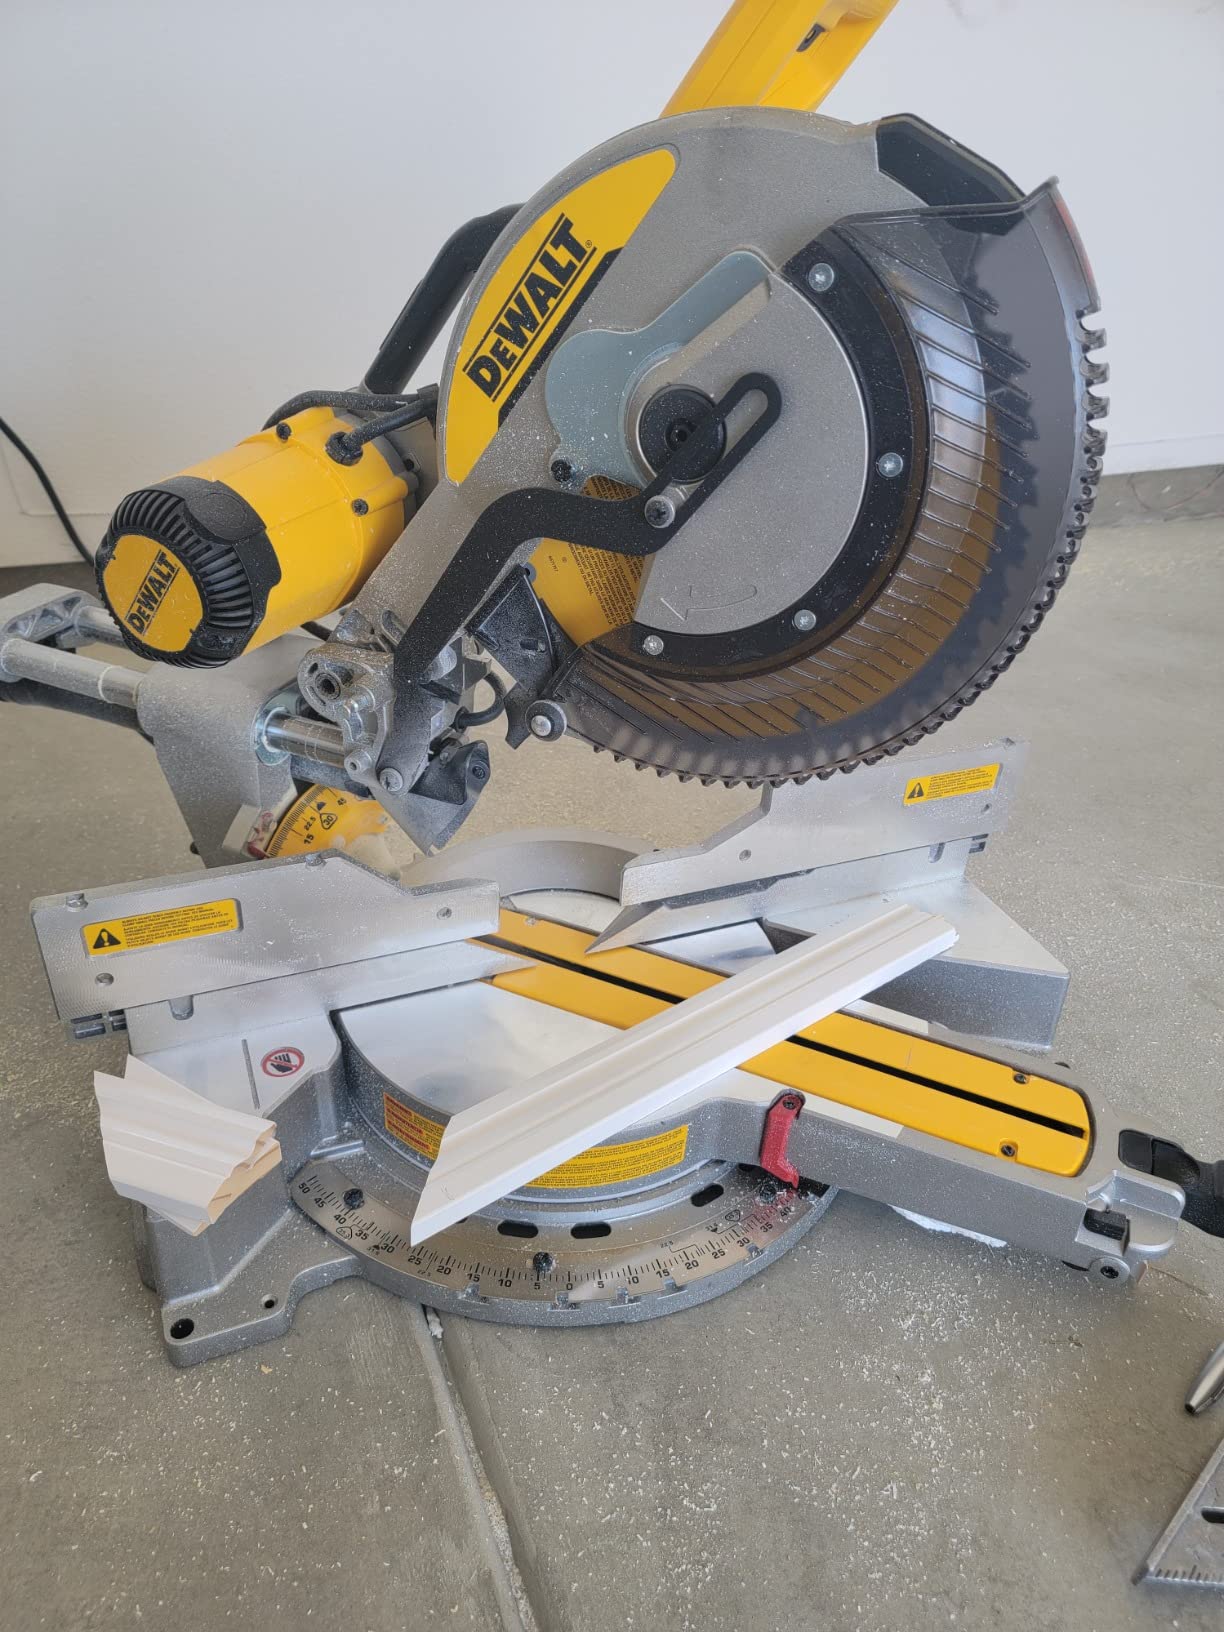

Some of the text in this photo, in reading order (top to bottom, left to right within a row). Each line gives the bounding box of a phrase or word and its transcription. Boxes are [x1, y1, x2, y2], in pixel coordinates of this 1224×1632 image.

[466, 216, 588, 398] DEWALT
[303, 833, 315, 845] 15
[322, 815, 333, 826] 30
[298, 1182, 311, 1194] 50
[314, 1197, 326, 1208] 45
[333, 1213, 347, 1225] 40
[355, 1229, 369, 1241] 35
[380, 1243, 395, 1254] 30
[407, 1255, 422, 1266] 25
[436, 1265, 452, 1275] 20
[466, 1273, 481, 1283] 15
[498, 1279, 513, 1288] 10
[534, 1282, 541, 1290] 5
[565, 1282, 573, 1291] 0
[597, 1280, 605, 1289] 5
[627, 1275, 640, 1285] 10
[655, 1268, 670, 1279] 15
[684, 1259, 699, 1270] 20
[711, 1248, 726, 1259] 25
[736, 1236, 750, 1247] 30
[760, 1221, 773, 1233] 35
[780, 1206, 792, 1218] 40
